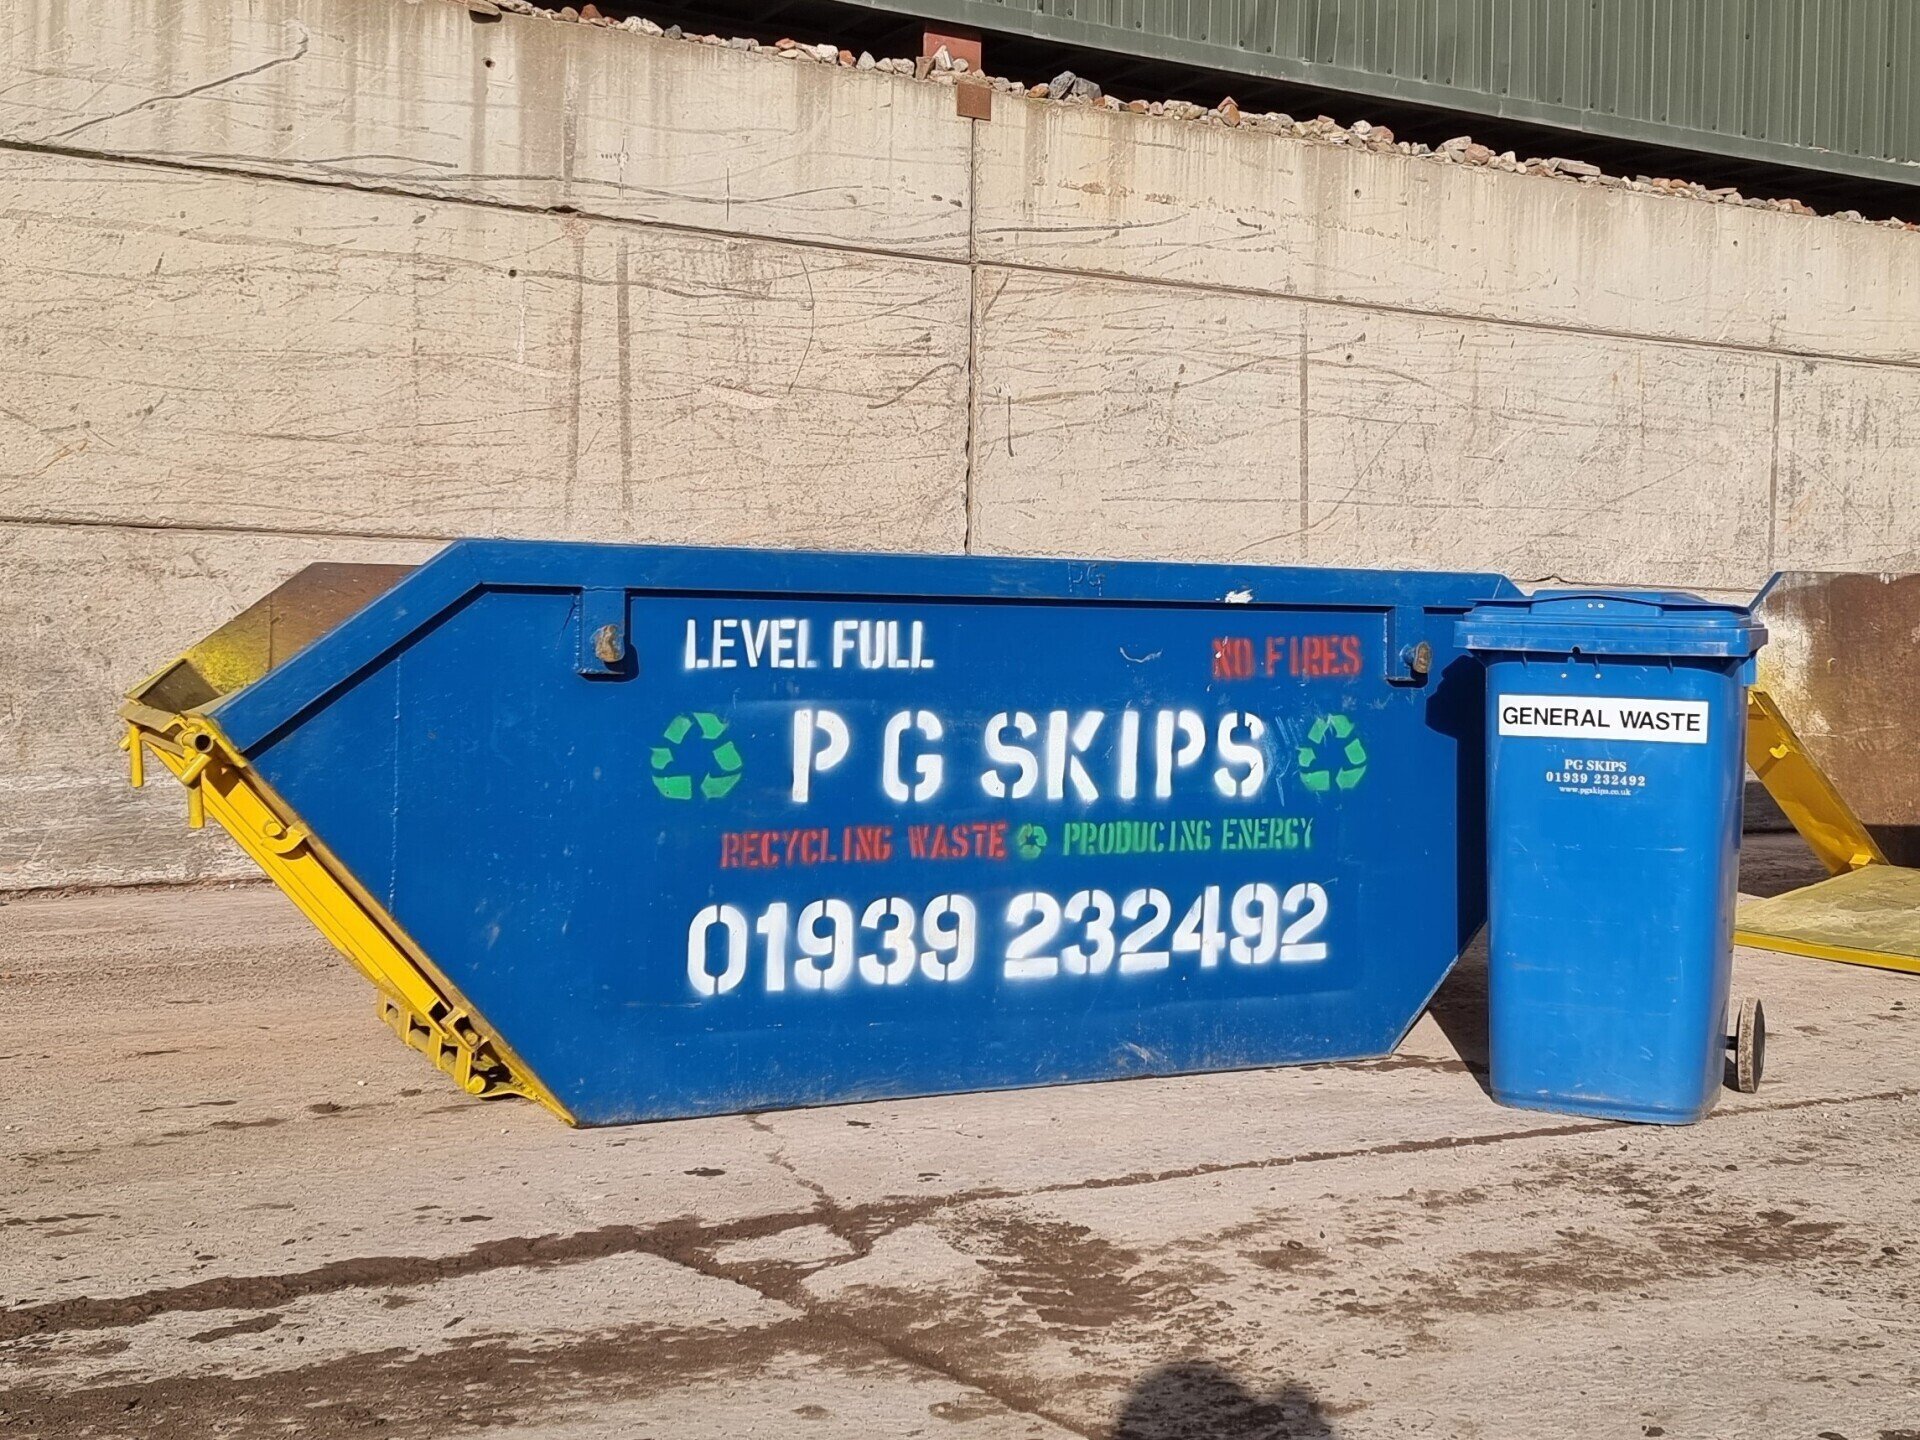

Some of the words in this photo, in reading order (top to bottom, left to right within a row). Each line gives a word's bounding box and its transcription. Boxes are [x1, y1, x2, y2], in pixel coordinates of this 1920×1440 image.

[685, 619, 817, 670] LEVEL
[832, 620, 934, 669] FULL
[1211, 636, 1255, 680] NO
[1266, 634, 1362, 678] FIRES
[1502, 706, 1611, 728] GENERAL
[1619, 709, 1701, 732] WASTE
[792, 709, 850, 803] P
[882, 710, 944, 802] G
[979, 709, 1266, 800] SKIPS
[1564, 758, 1584, 772] PG
[1586, 759, 1627, 773] SKIPS
[1545, 771, 1588, 784] 01939
[1593, 773, 1646, 787] 232492
[1558, 786, 1632, 797] www.pgskips.co.uk
[719, 824, 892, 869] RECYCLING
[907, 821, 1009, 862] WASTE
[1062, 818, 1212, 857] PRODUCING
[1220, 815, 1314, 851] ENERGY
[686, 893, 977, 996] 01939
[1003, 882, 1329, 980] 232492
